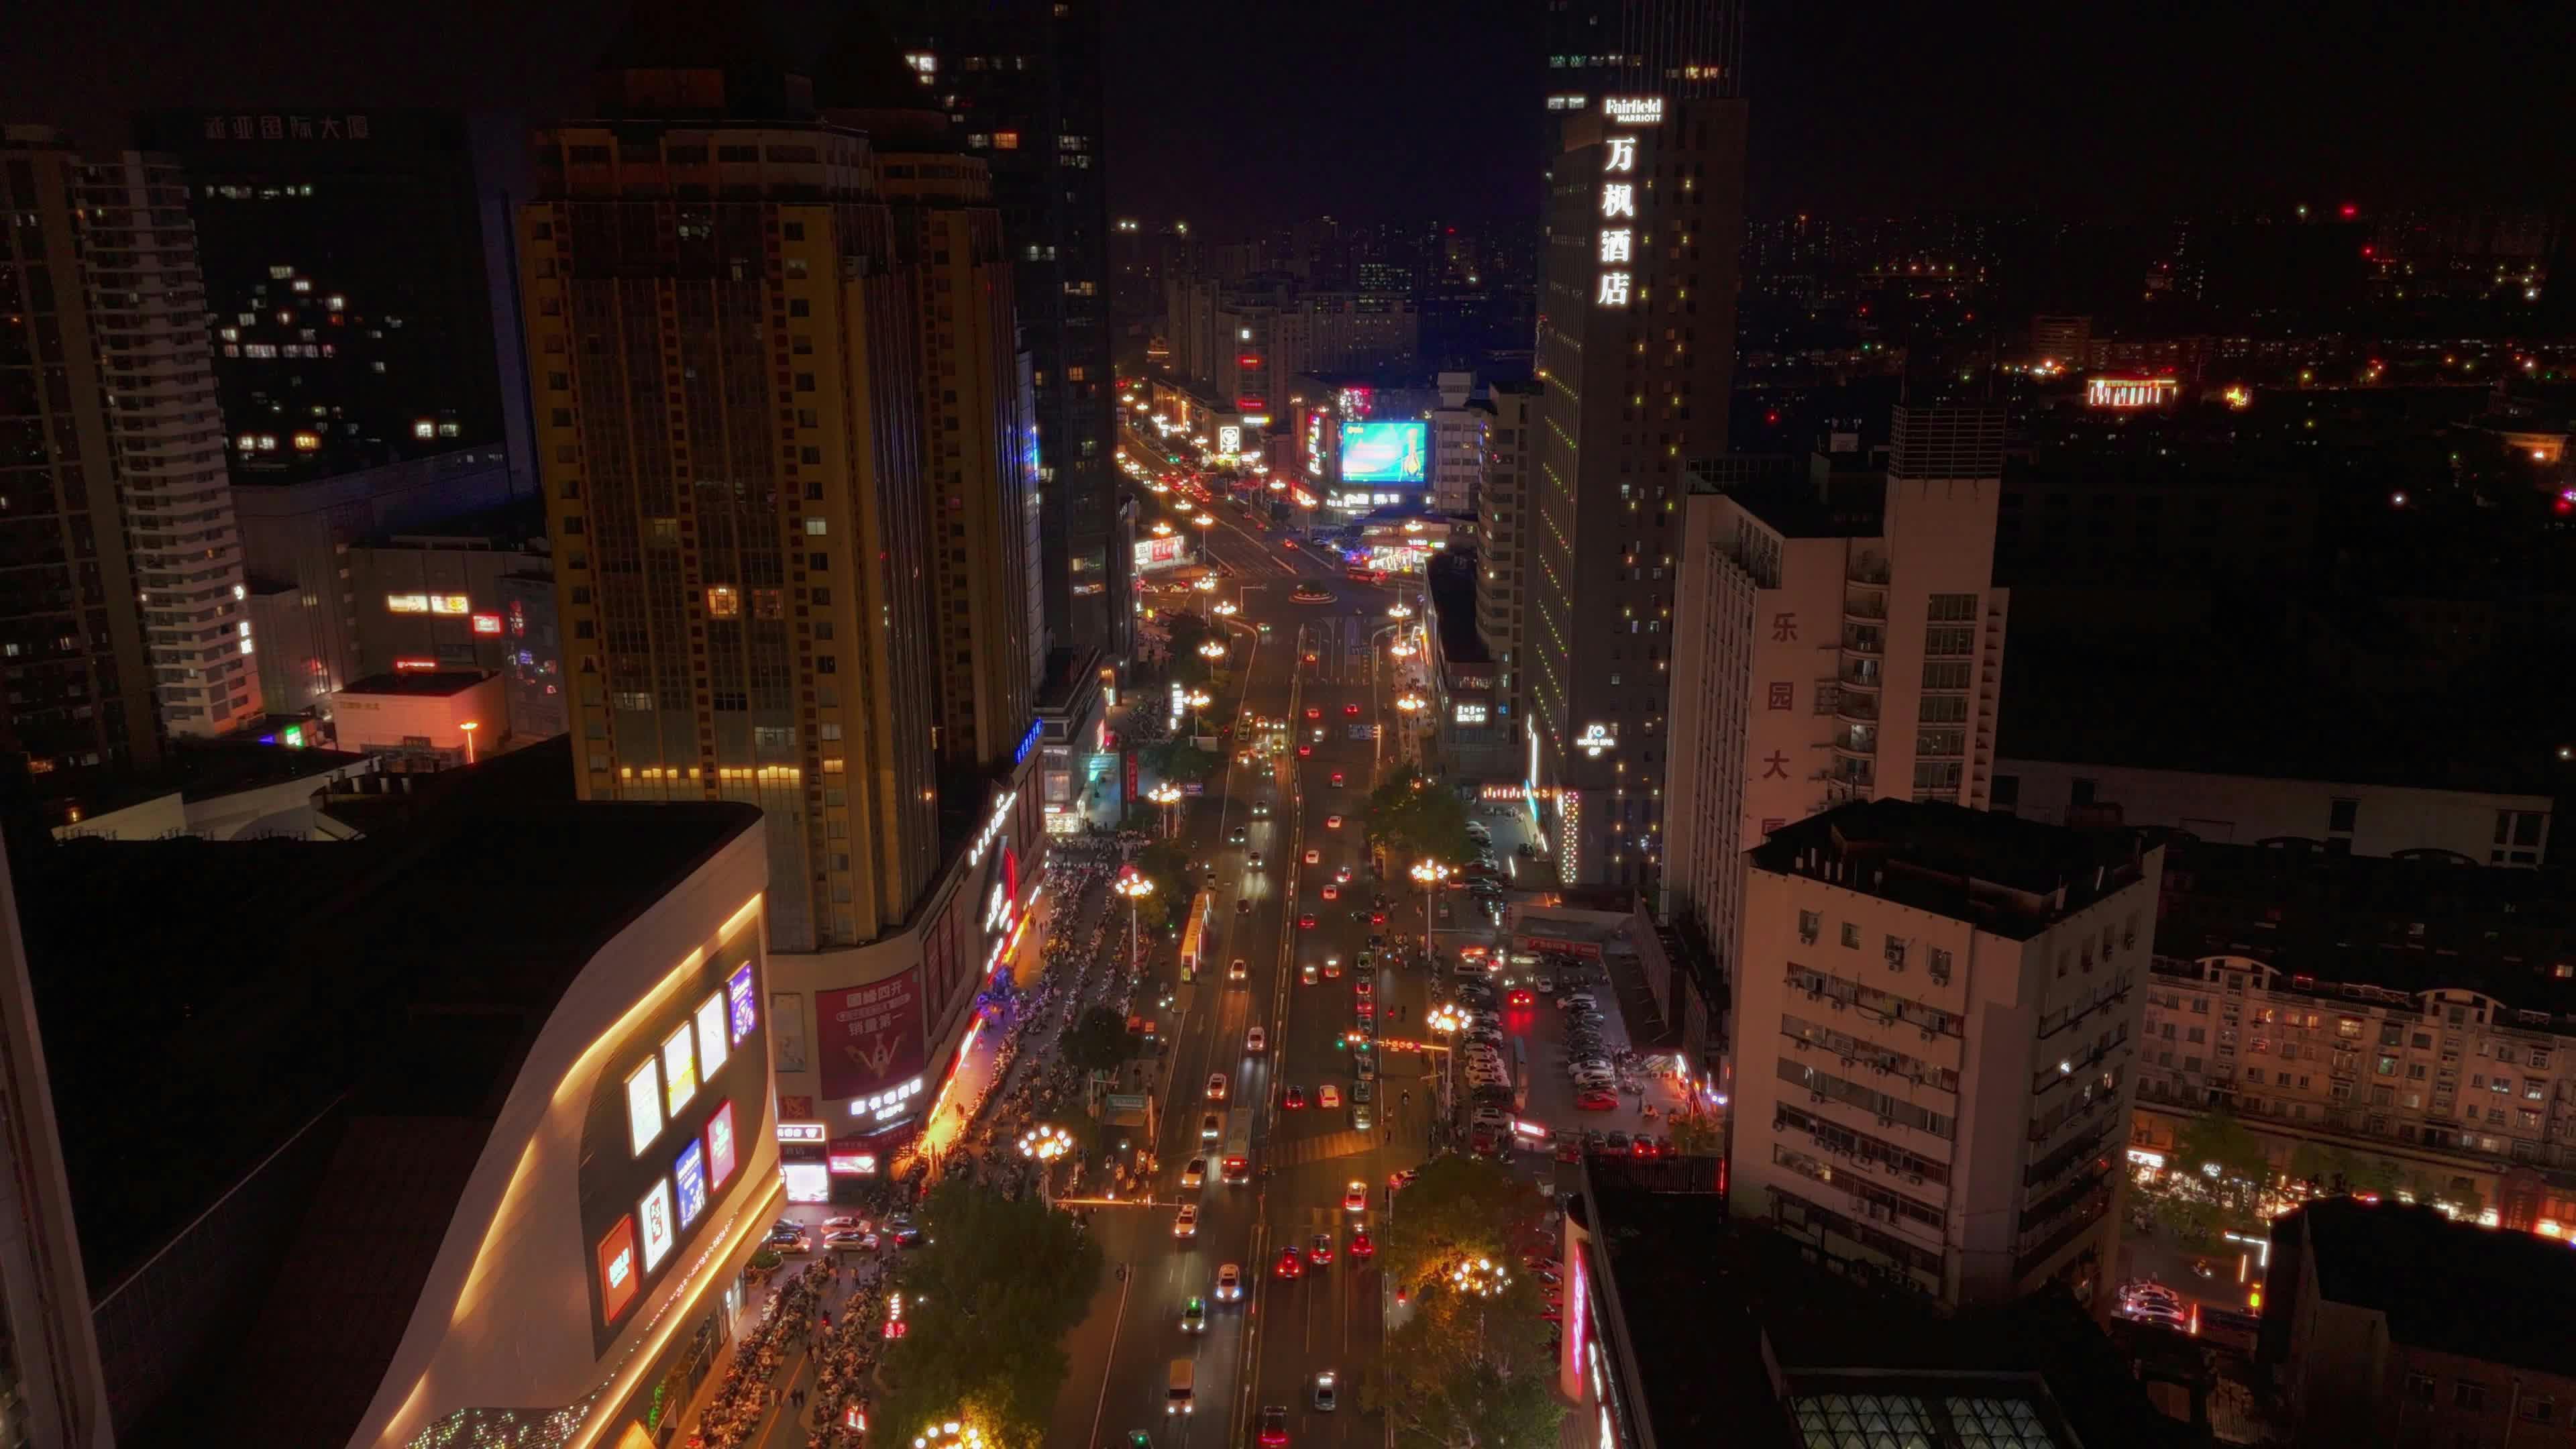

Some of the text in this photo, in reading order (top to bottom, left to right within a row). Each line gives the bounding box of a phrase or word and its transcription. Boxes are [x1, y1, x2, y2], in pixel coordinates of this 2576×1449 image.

[1605, 98, 1662, 114] Fairfield
[1617, 114, 1662, 122] MARRIOTT
[1599, 137, 1636, 305] 万枫酒店
